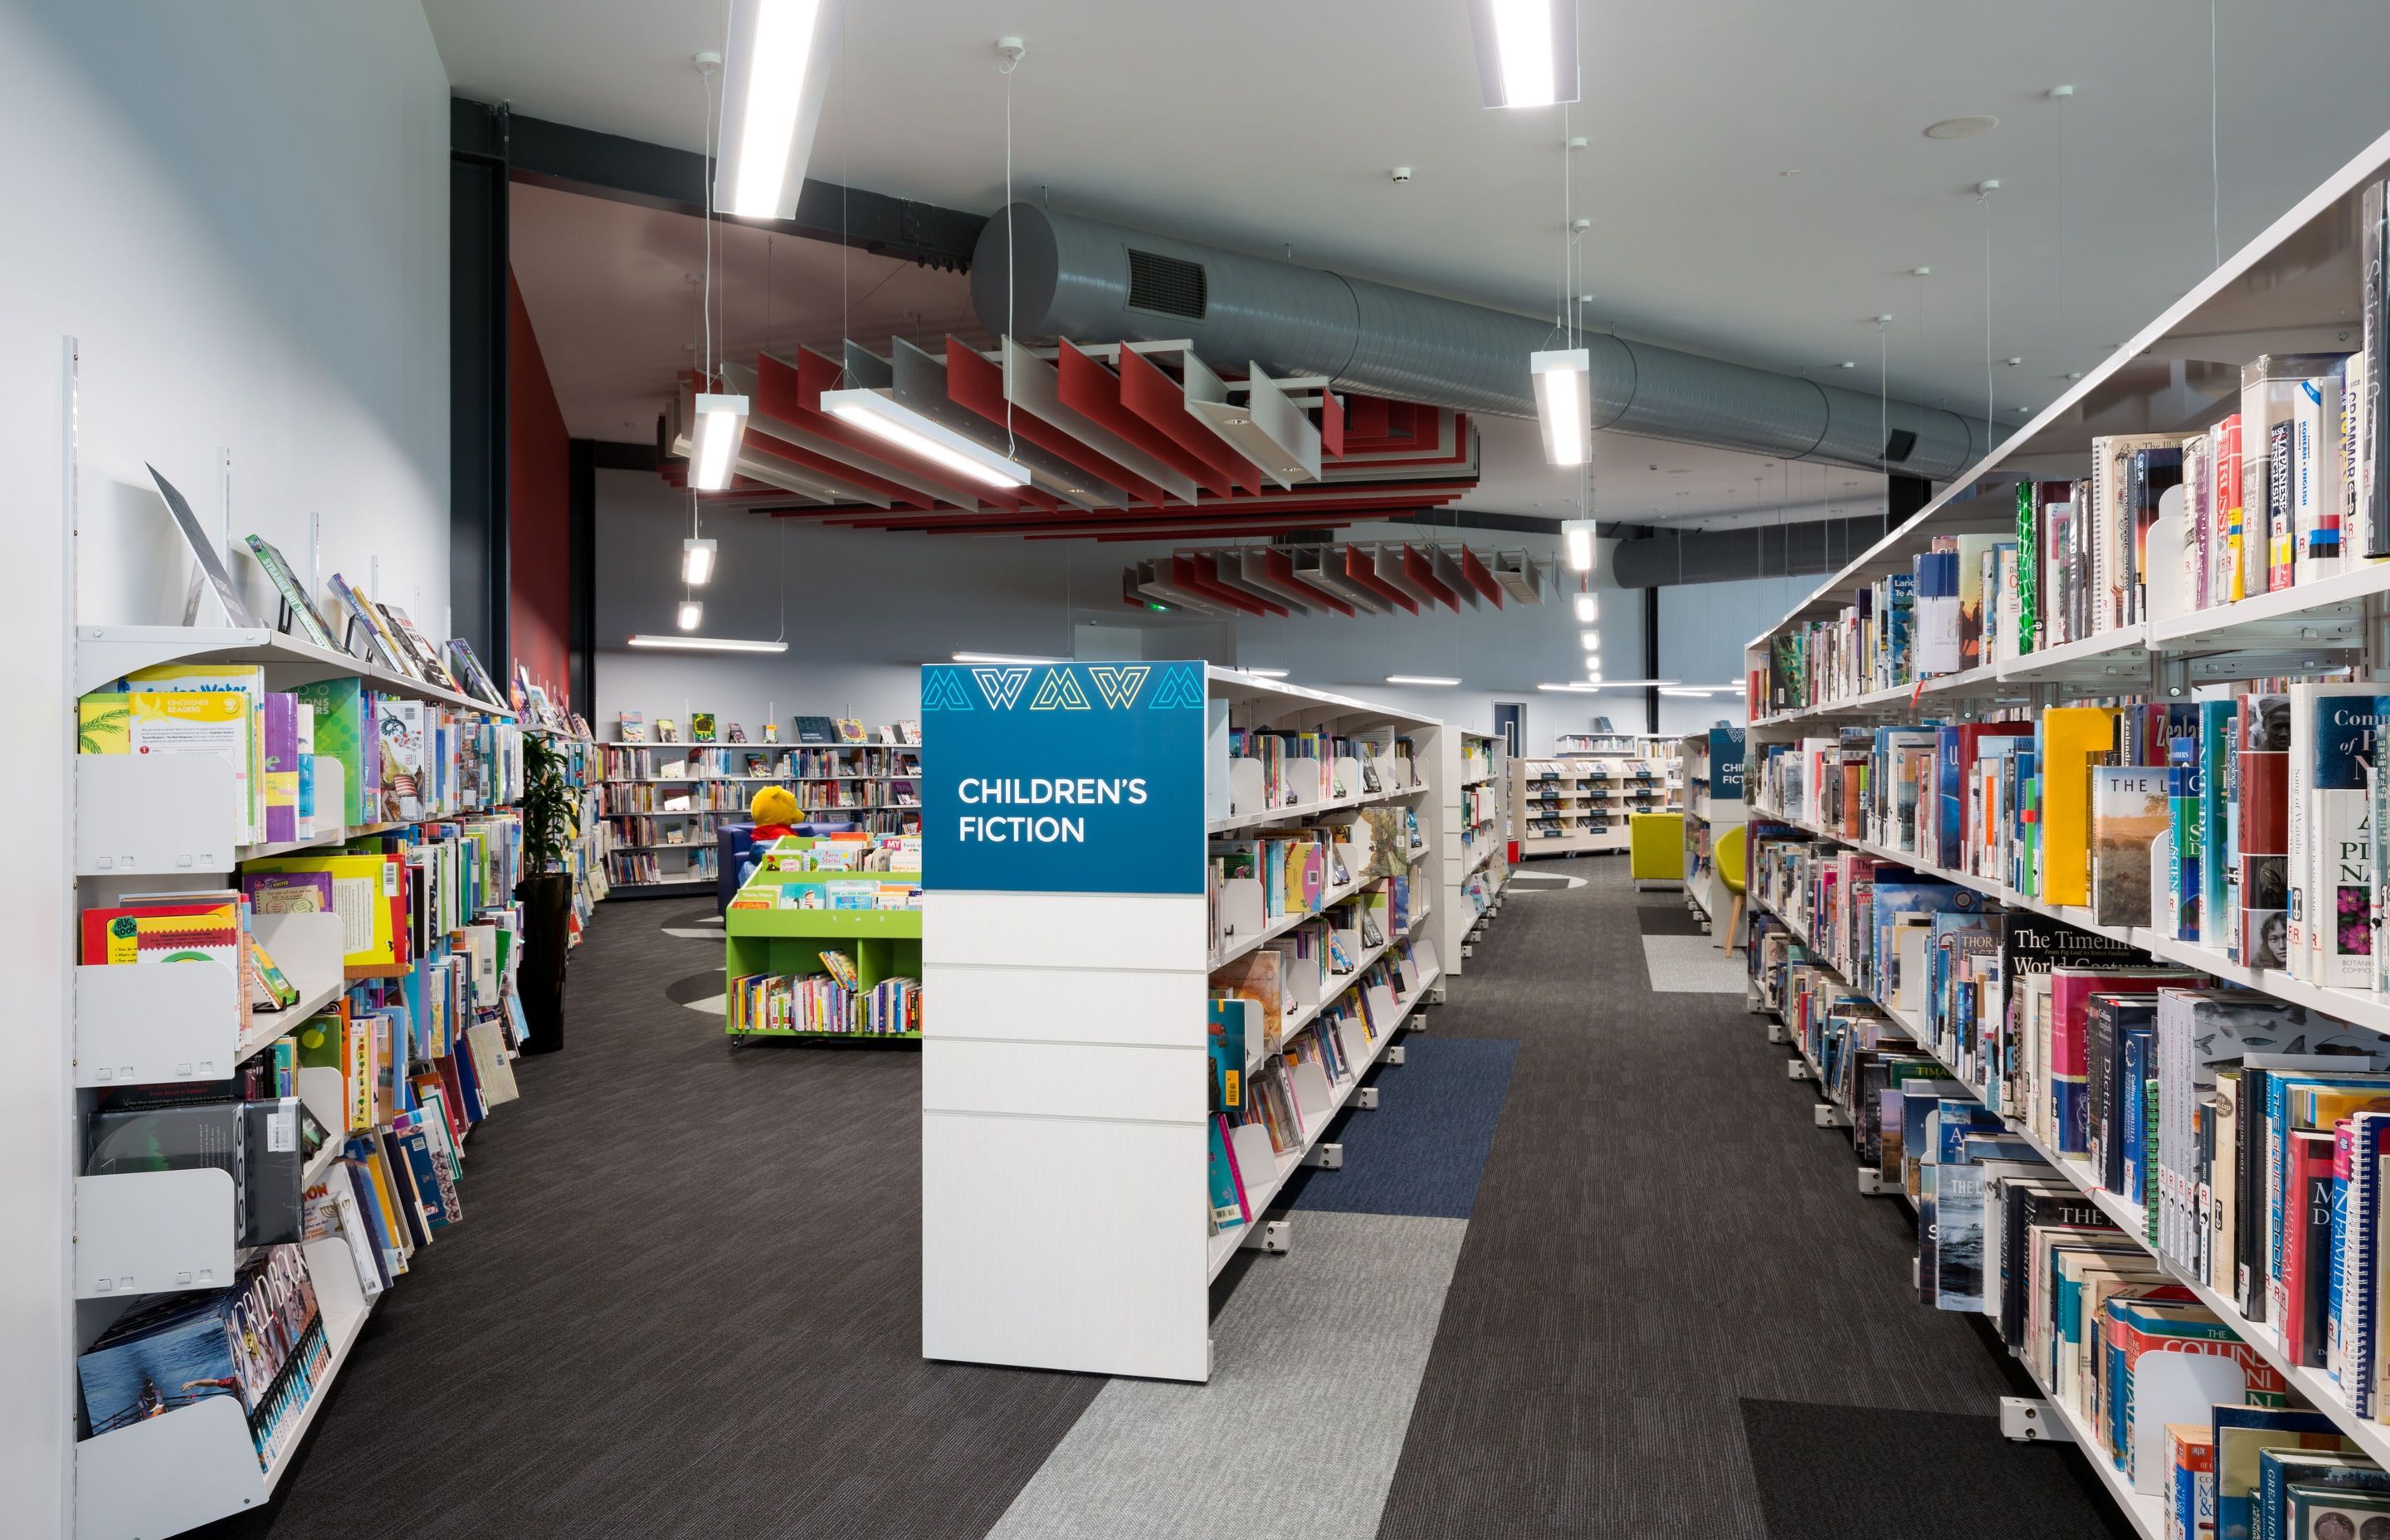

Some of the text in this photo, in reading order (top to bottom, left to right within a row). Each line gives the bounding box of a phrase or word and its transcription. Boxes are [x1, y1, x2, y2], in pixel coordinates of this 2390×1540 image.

[2347, 392, 2357, 479] GRAMMAR
[2339, 737, 2358, 755] of
[2230, 750, 2238, 789] Geology
[958, 777, 1148, 805] CHILDREN'S
[2111, 779, 2148, 792] THE
[2291, 768, 2301, 795] Song
[959, 816, 1084, 842] FICTION
[887, 841, 901, 849] MY
[1856, 860, 1873, 870] The
[117, 919, 133, 928] BUG
[1961, 936, 1992, 948] THOR
[2014, 928, 2051, 948] The
[2013, 956, 2066, 975] World
[1915, 1066, 1950, 1076] TIMA
[2103, 1055, 2111, 1118] Dictio
[1951, 1178, 1973, 1194] THE
[2271, 1090, 2282, 1283] THE GADGET BOOK
[2058, 1207, 2103, 1226] THE
[2334, 1216, 2348, 1292] FAMILY
[2207, 1328, 2228, 1339] THE
[2192, 1446, 2206, 1455] DK
[2199, 1475, 2213, 1484] CO
[2267, 1469, 2275, 1514] GREAT
